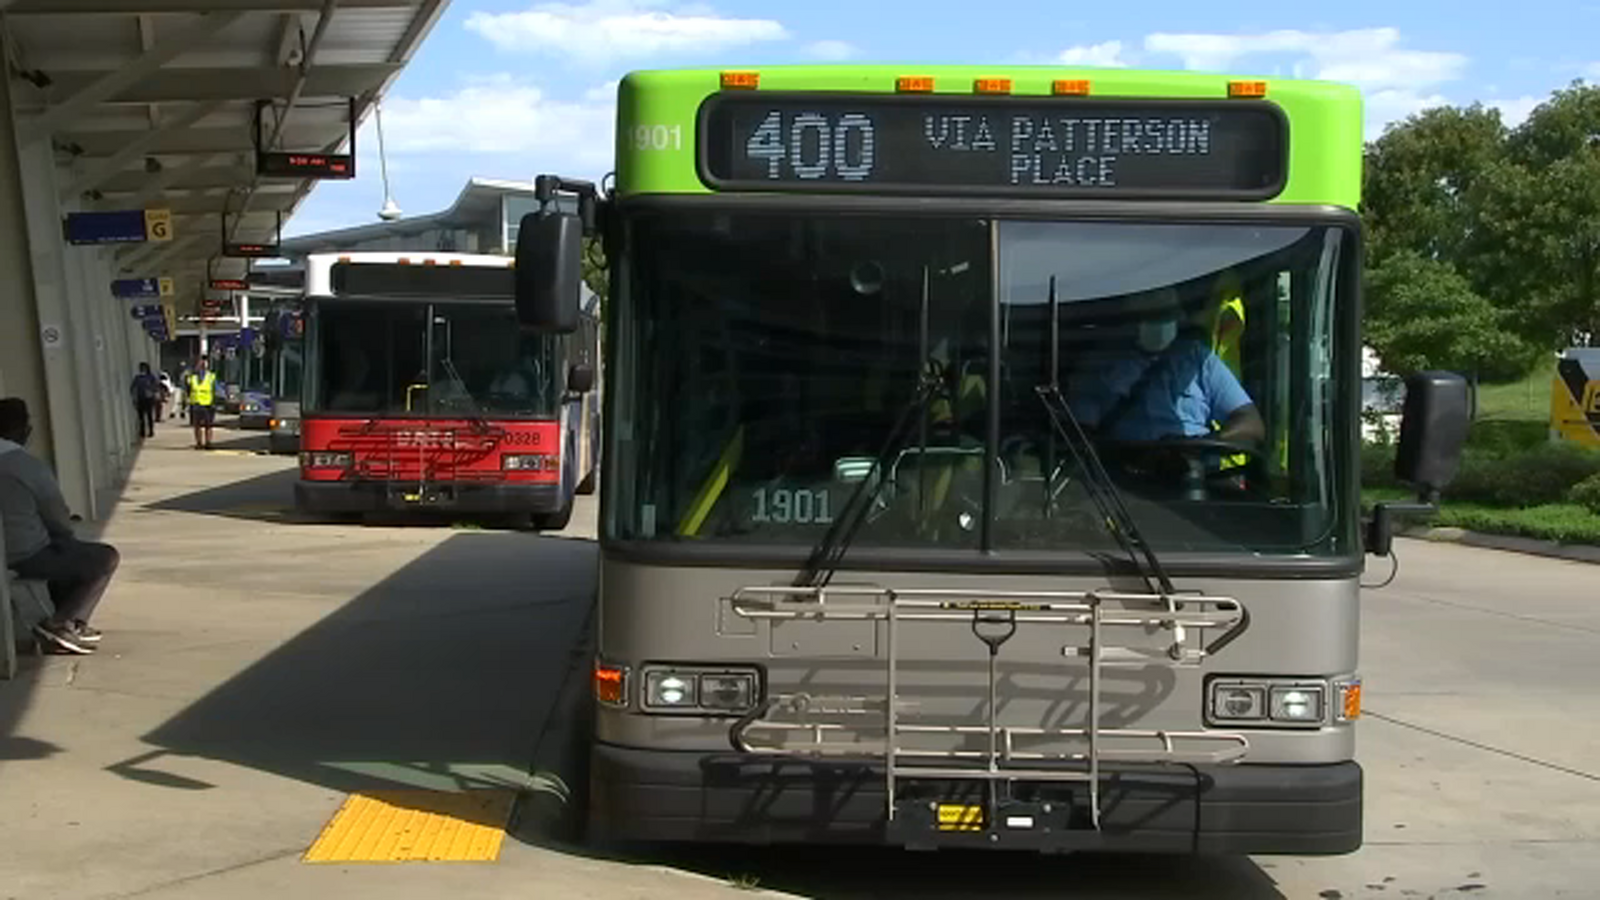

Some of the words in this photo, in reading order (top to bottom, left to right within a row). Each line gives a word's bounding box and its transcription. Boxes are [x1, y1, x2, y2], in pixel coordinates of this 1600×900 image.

[747, 111, 874, 181] 400
[924, 116, 995, 150] VIA
[1011, 117, 1210, 154] PATTERSON
[1011, 154, 1116, 186] PLACE
[152, 222, 166, 238] G
[504, 431, 541, 446] 0328
[751, 487, 834, 523] 1901
